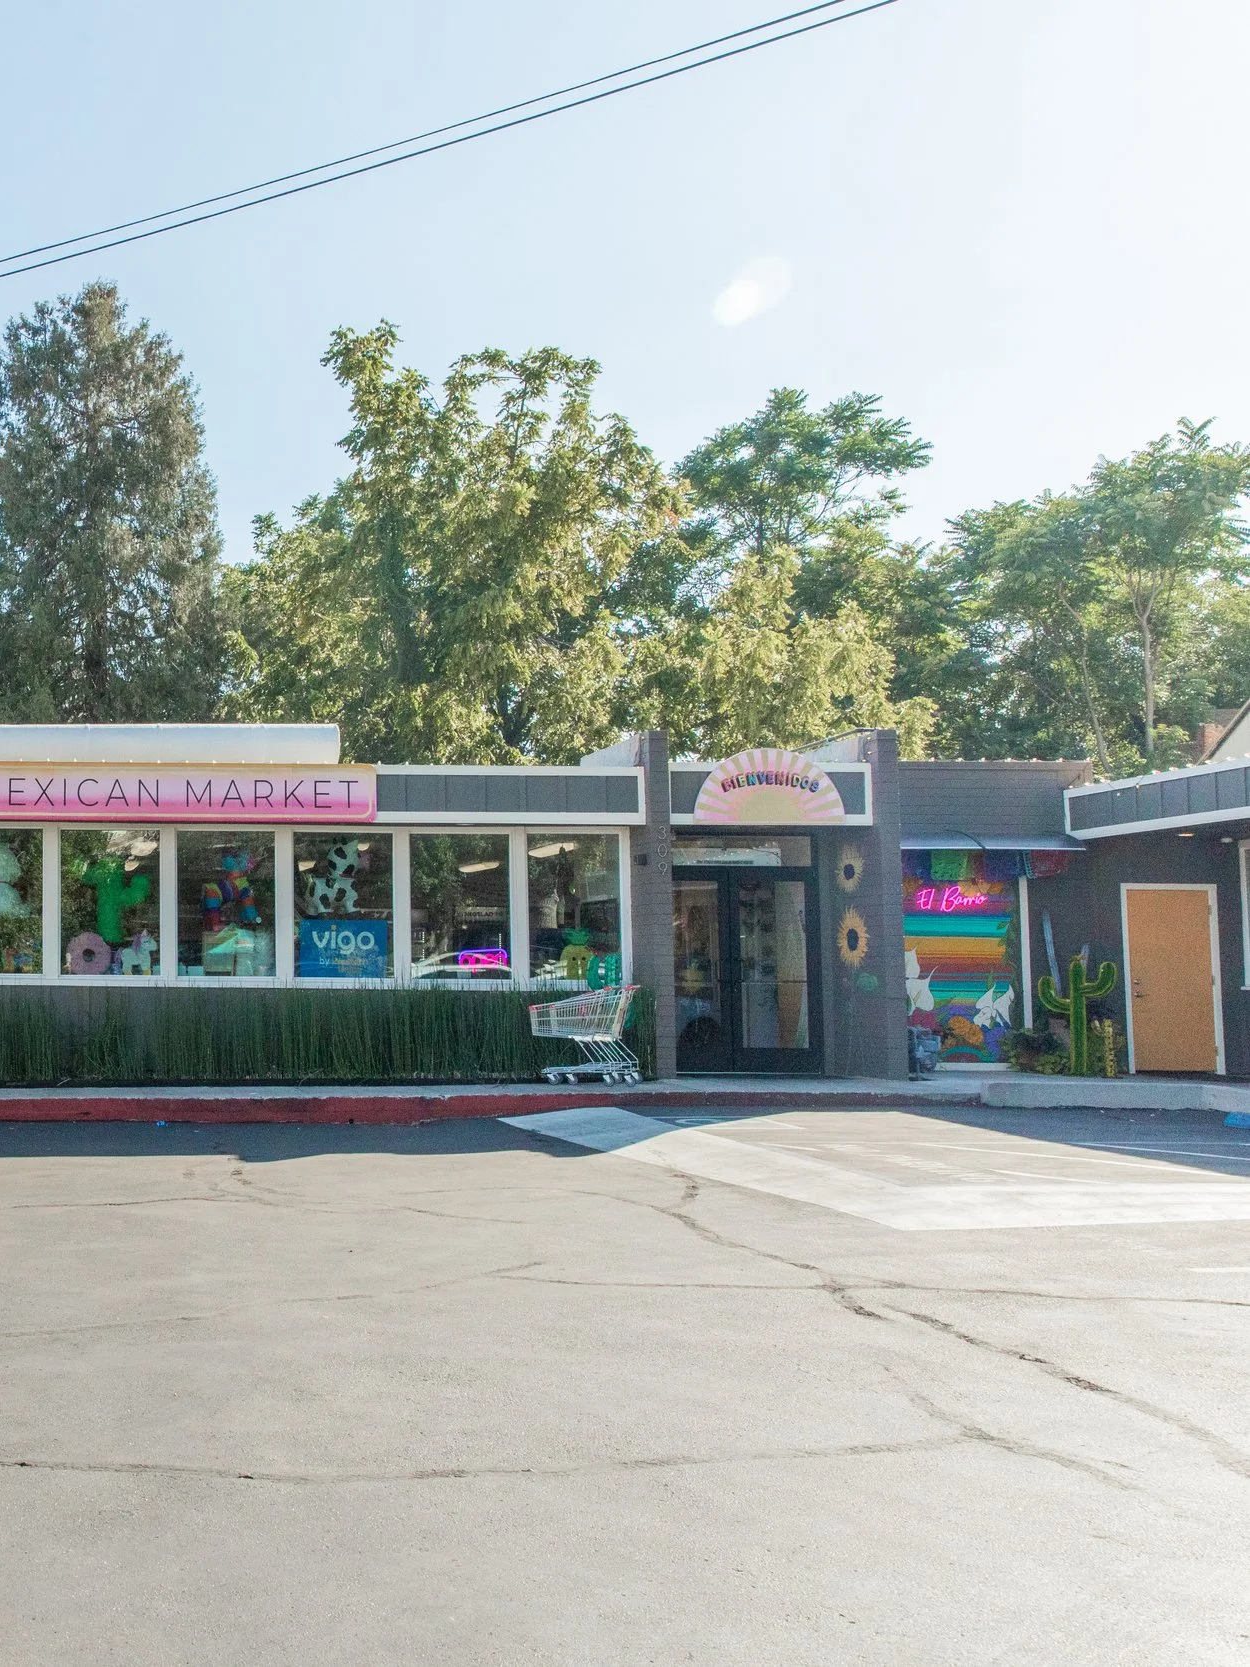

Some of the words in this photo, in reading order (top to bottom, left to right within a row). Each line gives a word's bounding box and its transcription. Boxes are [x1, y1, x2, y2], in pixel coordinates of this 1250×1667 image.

[185, 779, 359, 809] MARKET
[720, 770, 820, 793] BIENVENIDOS
[658, 826, 668, 875] 309
[917, 888, 935, 910] El
[940, 886, 988, 912] Barrio
[311, 924, 375, 955] vigo
[319, 957, 330, 966] by
